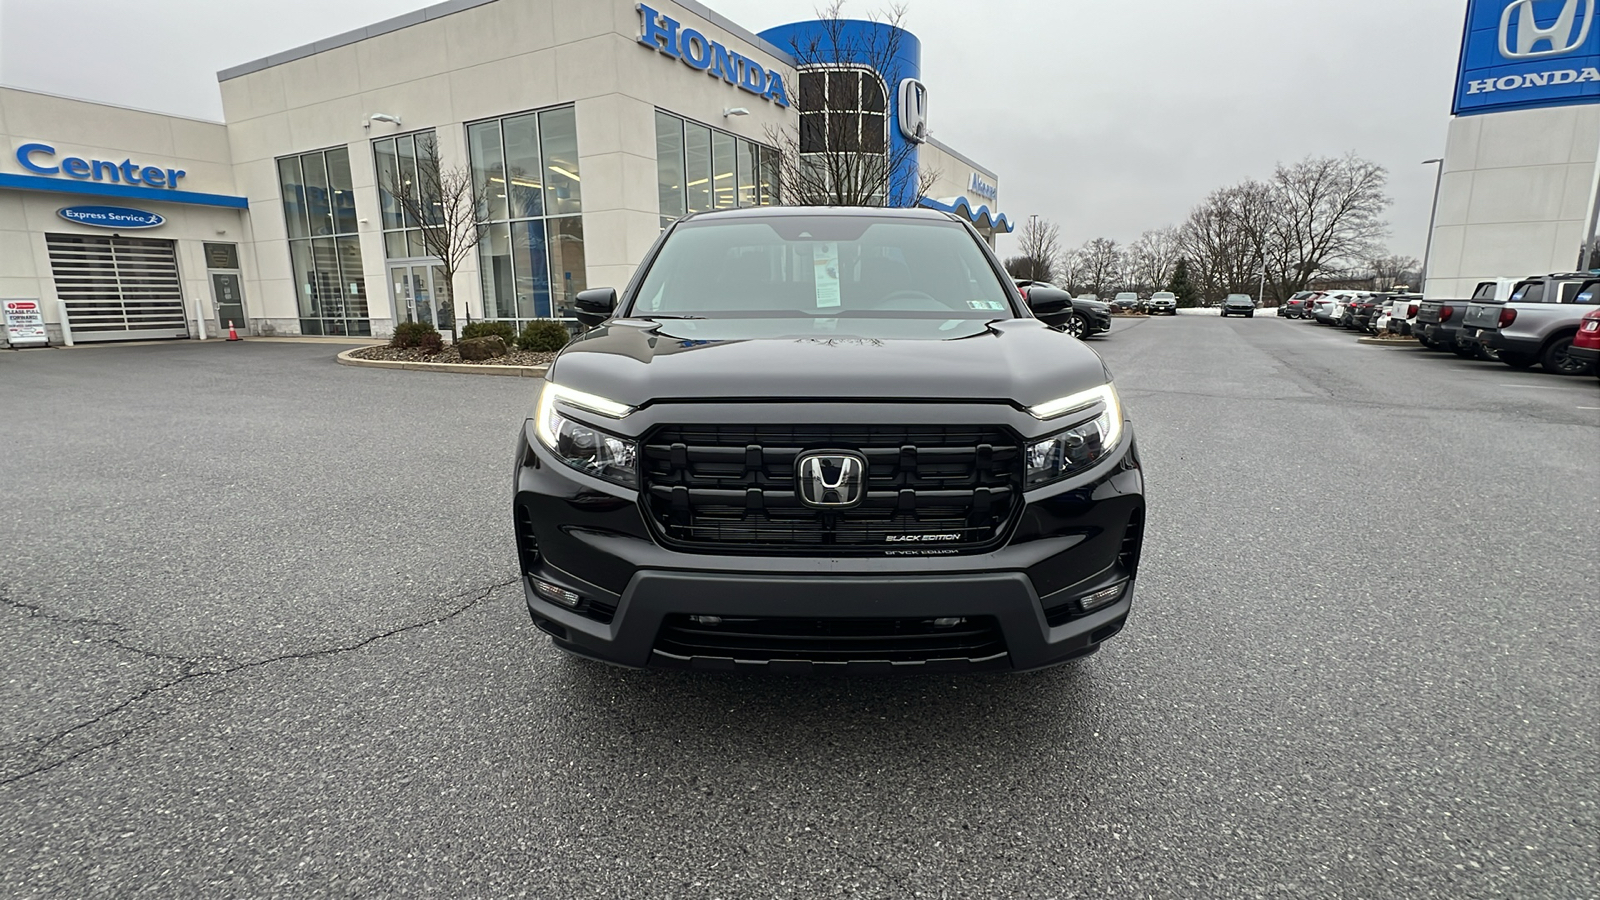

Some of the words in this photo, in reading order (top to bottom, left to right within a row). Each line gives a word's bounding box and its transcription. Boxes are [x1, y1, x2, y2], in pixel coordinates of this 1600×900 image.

[636, 3, 790, 109] HONDA
[1466, 67, 1600, 95] HONDA
[16, 142, 187, 189] Center
[65, 209, 107, 220] Express
[108, 212, 145, 223] Service
[921, 533, 961, 541] EDITION
